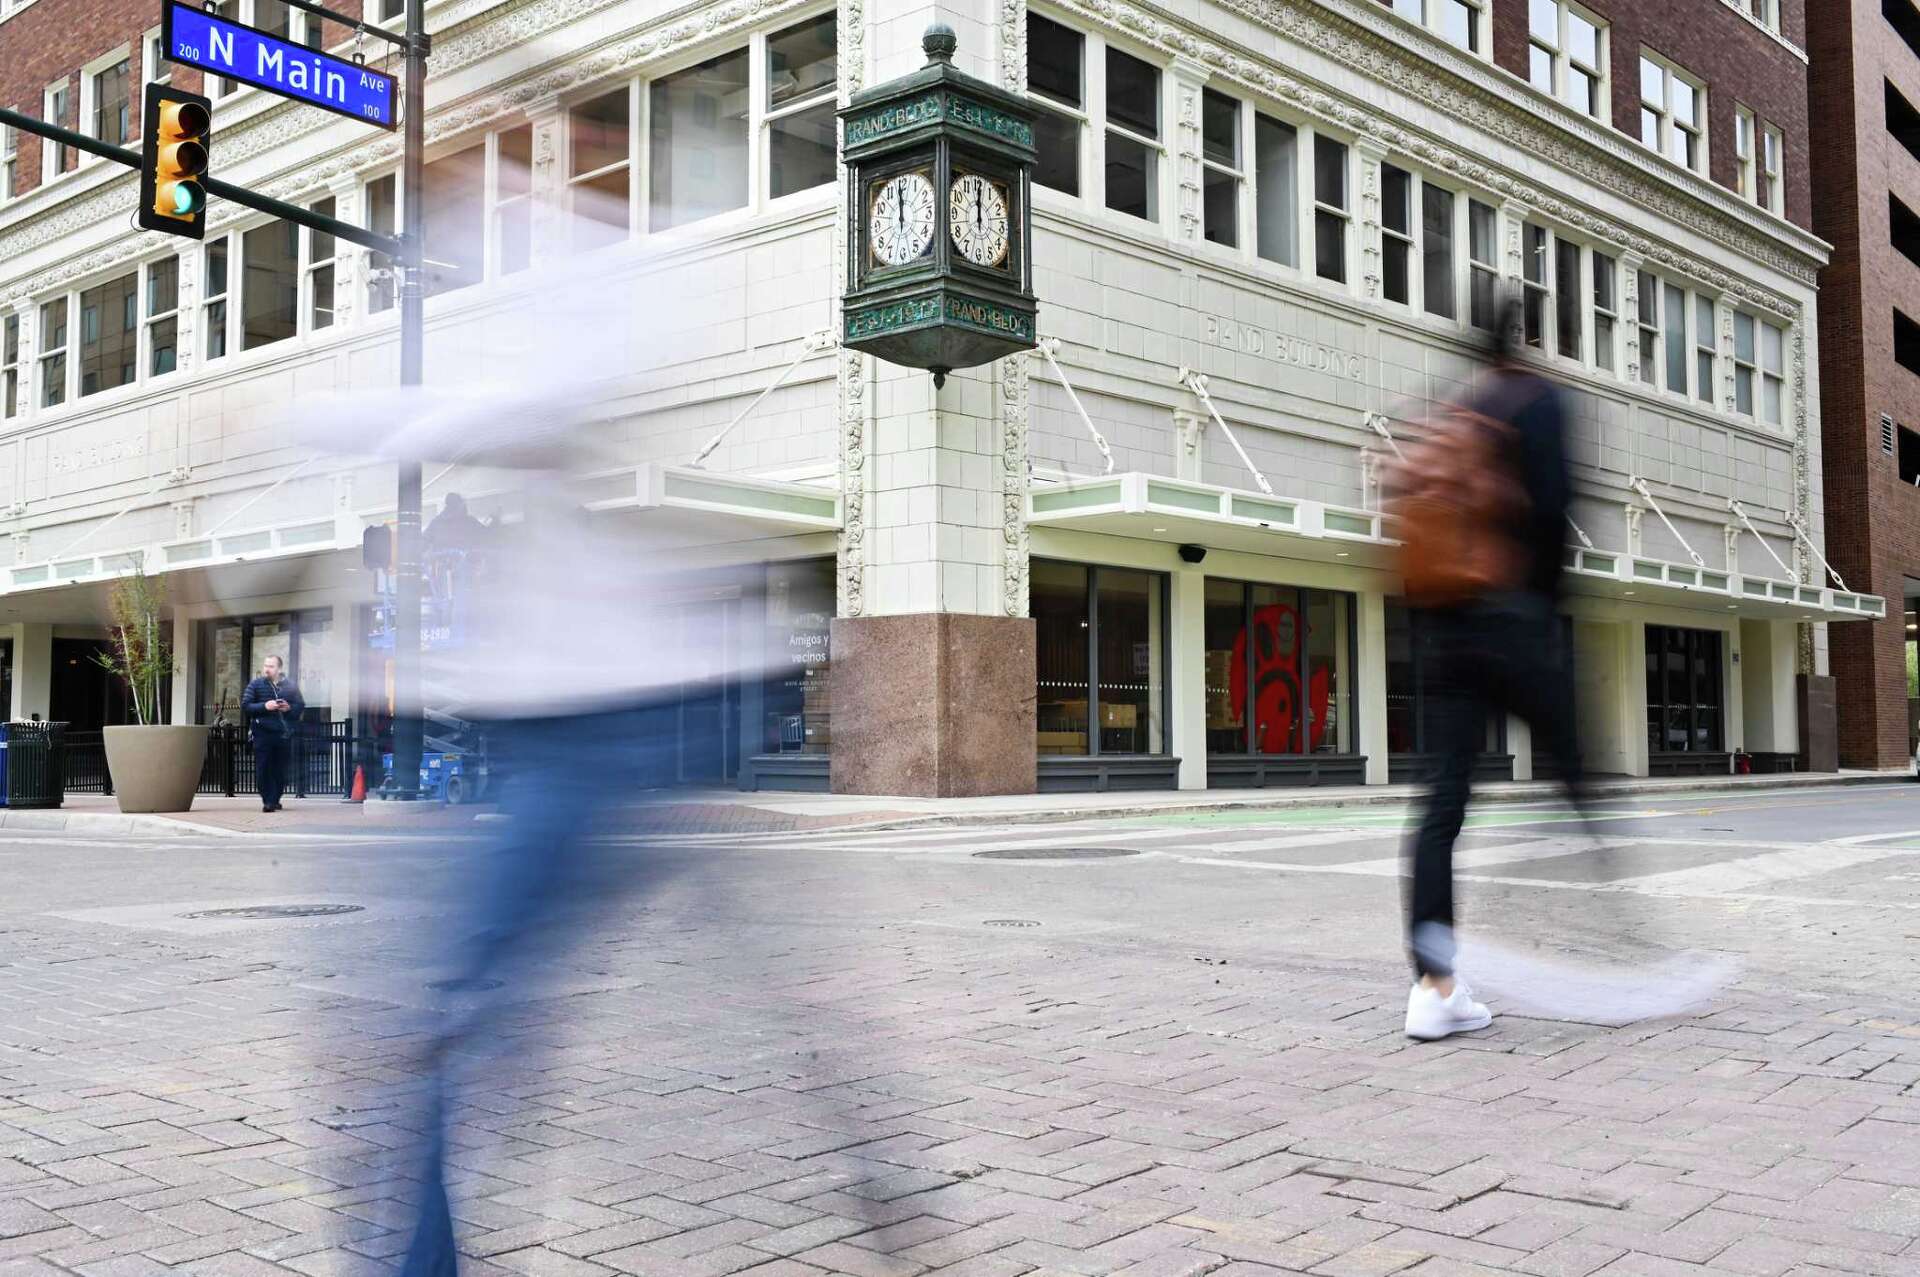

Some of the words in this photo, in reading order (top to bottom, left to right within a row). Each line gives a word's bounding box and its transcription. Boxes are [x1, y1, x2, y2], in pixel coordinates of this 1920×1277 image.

[179, 43, 200, 60] 200
[209, 26, 234, 67] N
[257, 42, 345, 103] Main
[360, 72, 384, 93] Ave
[363, 103, 380, 119] 100
[1207, 316, 1265, 353] RAND
[1276, 335, 1361, 378] BUILDING
[788, 633, 821, 648] Amigos
[823, 635, 829, 647] y
[791, 651, 826, 663] vecinos
